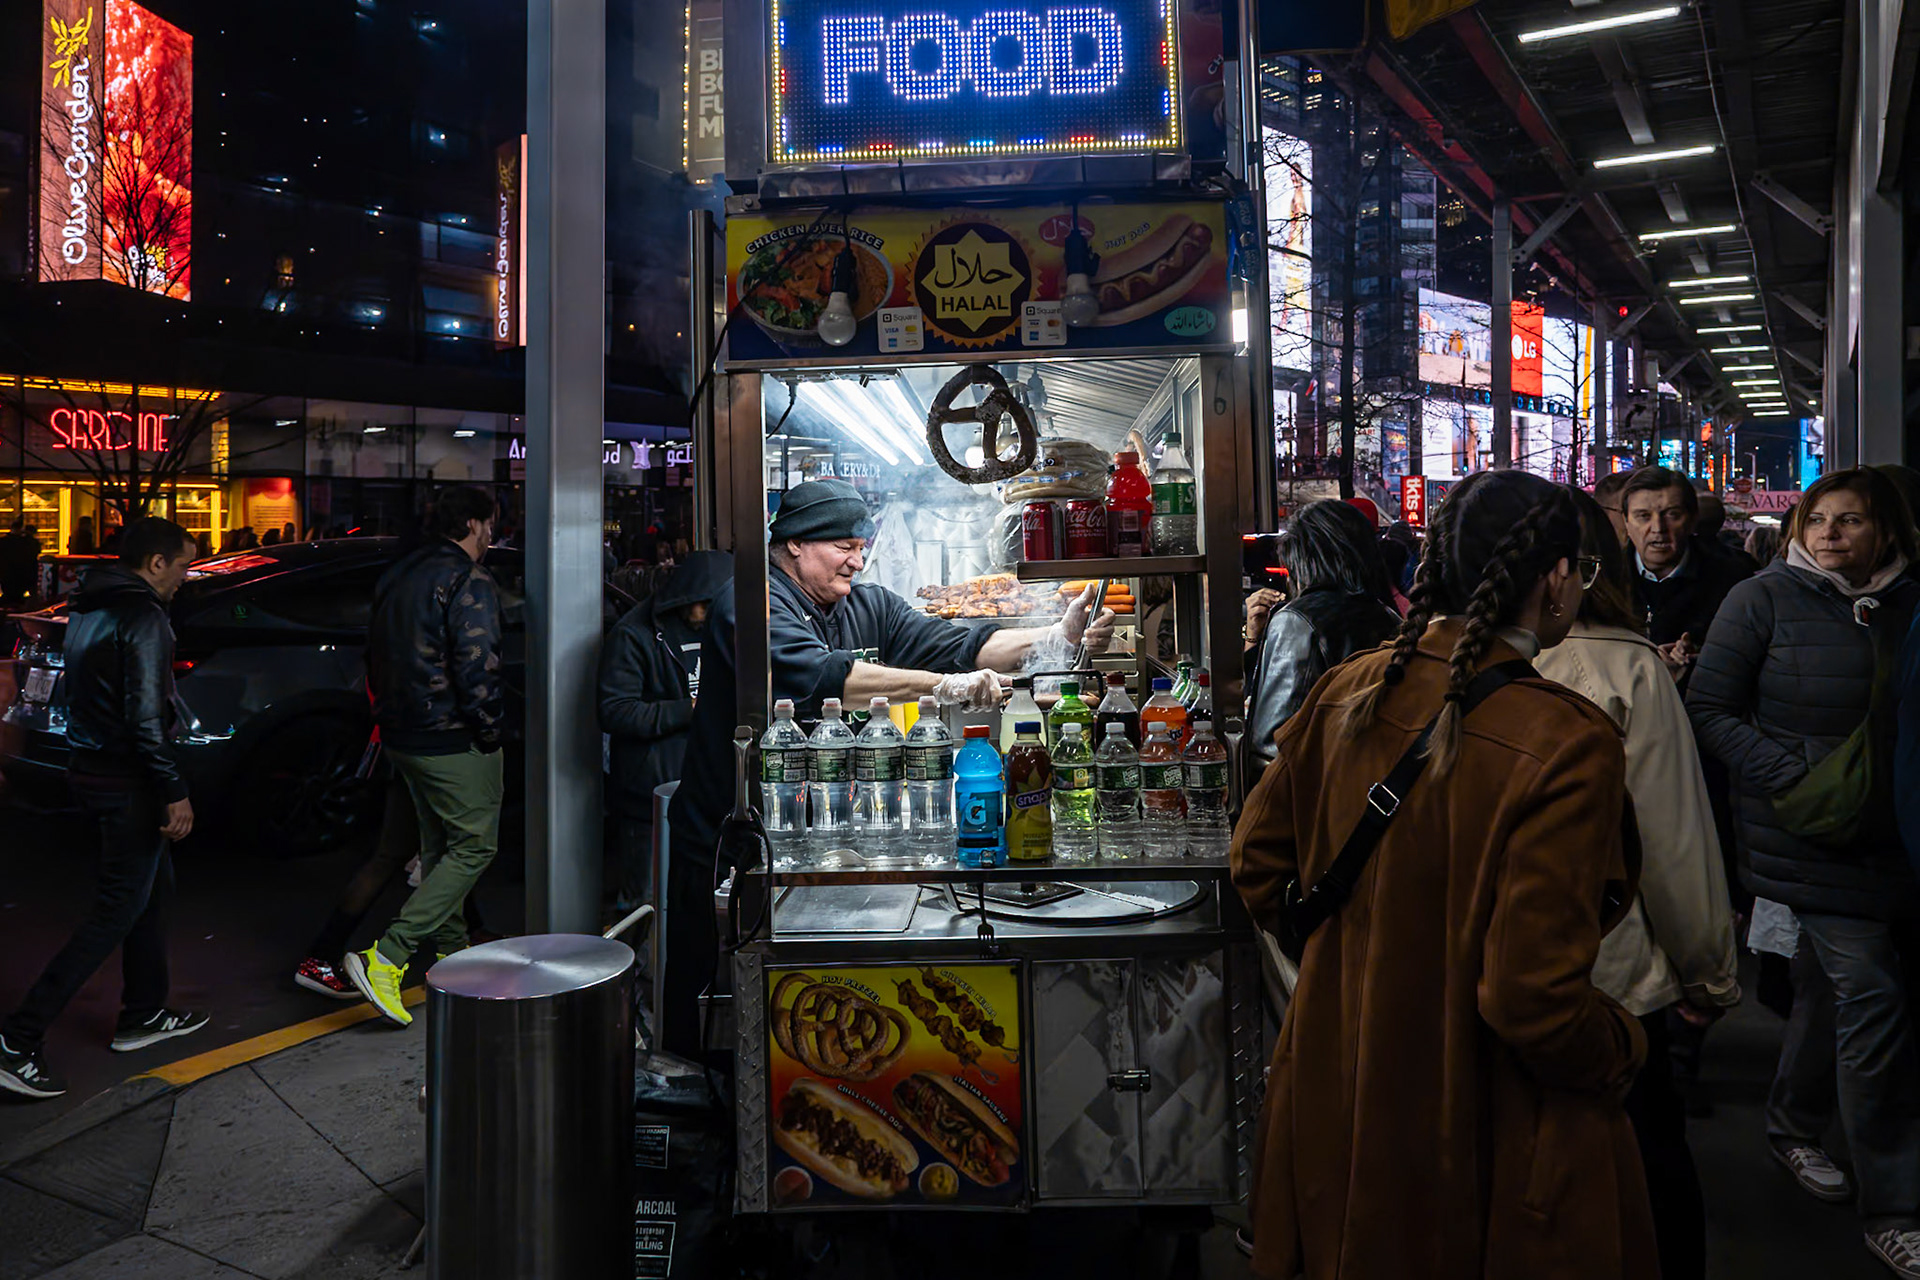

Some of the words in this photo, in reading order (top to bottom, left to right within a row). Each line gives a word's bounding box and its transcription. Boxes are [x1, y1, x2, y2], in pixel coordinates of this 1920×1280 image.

[823, 8, 1124, 103] FOOD
[65, 57, 95, 178] Garden
[62, 180, 88, 264] Olive
[746, 224, 806, 253] CHICKEN
[850, 227, 883, 250] RICE
[934, 247, 1013, 289] حلال
[942, 295, 1008, 311] HALAL
[1523, 340, 1537, 358] LG
[1406, 477, 1422, 510] tkts
[965, 800, 987, 825] G
[822, 975, 841, 985] HOT
[845, 977, 881, 1005] PRETZEL
[953, 1076, 982, 1097] ITALIAN
[982, 1096, 1009, 1124] SAUSAGE
